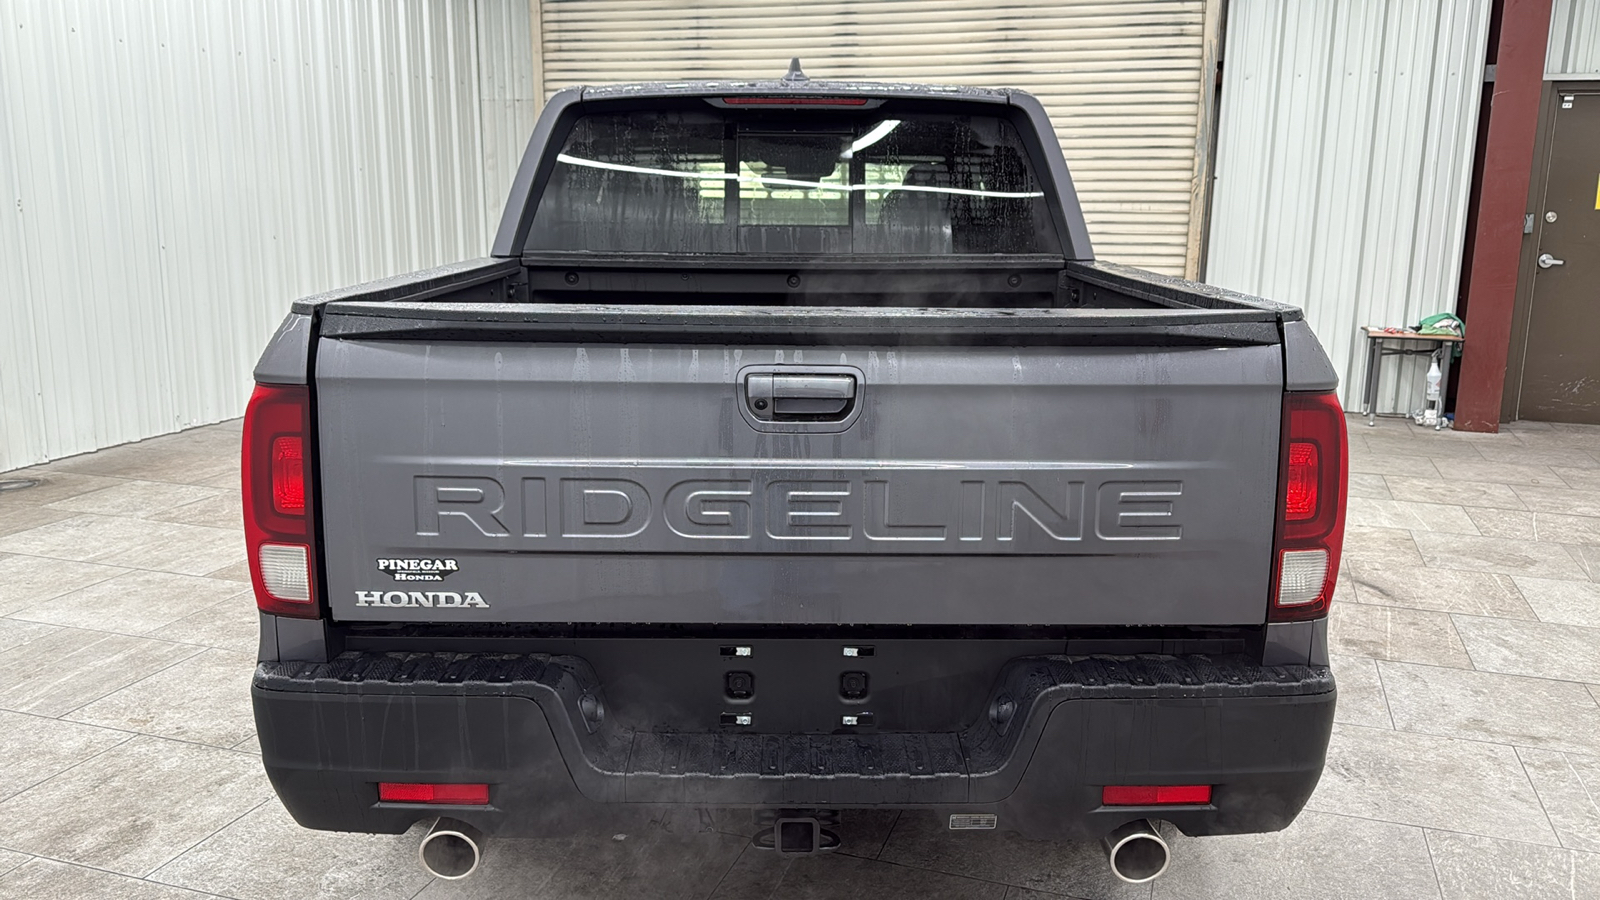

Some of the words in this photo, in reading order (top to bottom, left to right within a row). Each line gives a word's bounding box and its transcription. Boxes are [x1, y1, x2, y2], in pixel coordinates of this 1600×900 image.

[413, 476, 1184, 541] RIDGELINE
[378, 559, 458, 570] PINEGAR
[355, 591, 490, 608] HONDA
